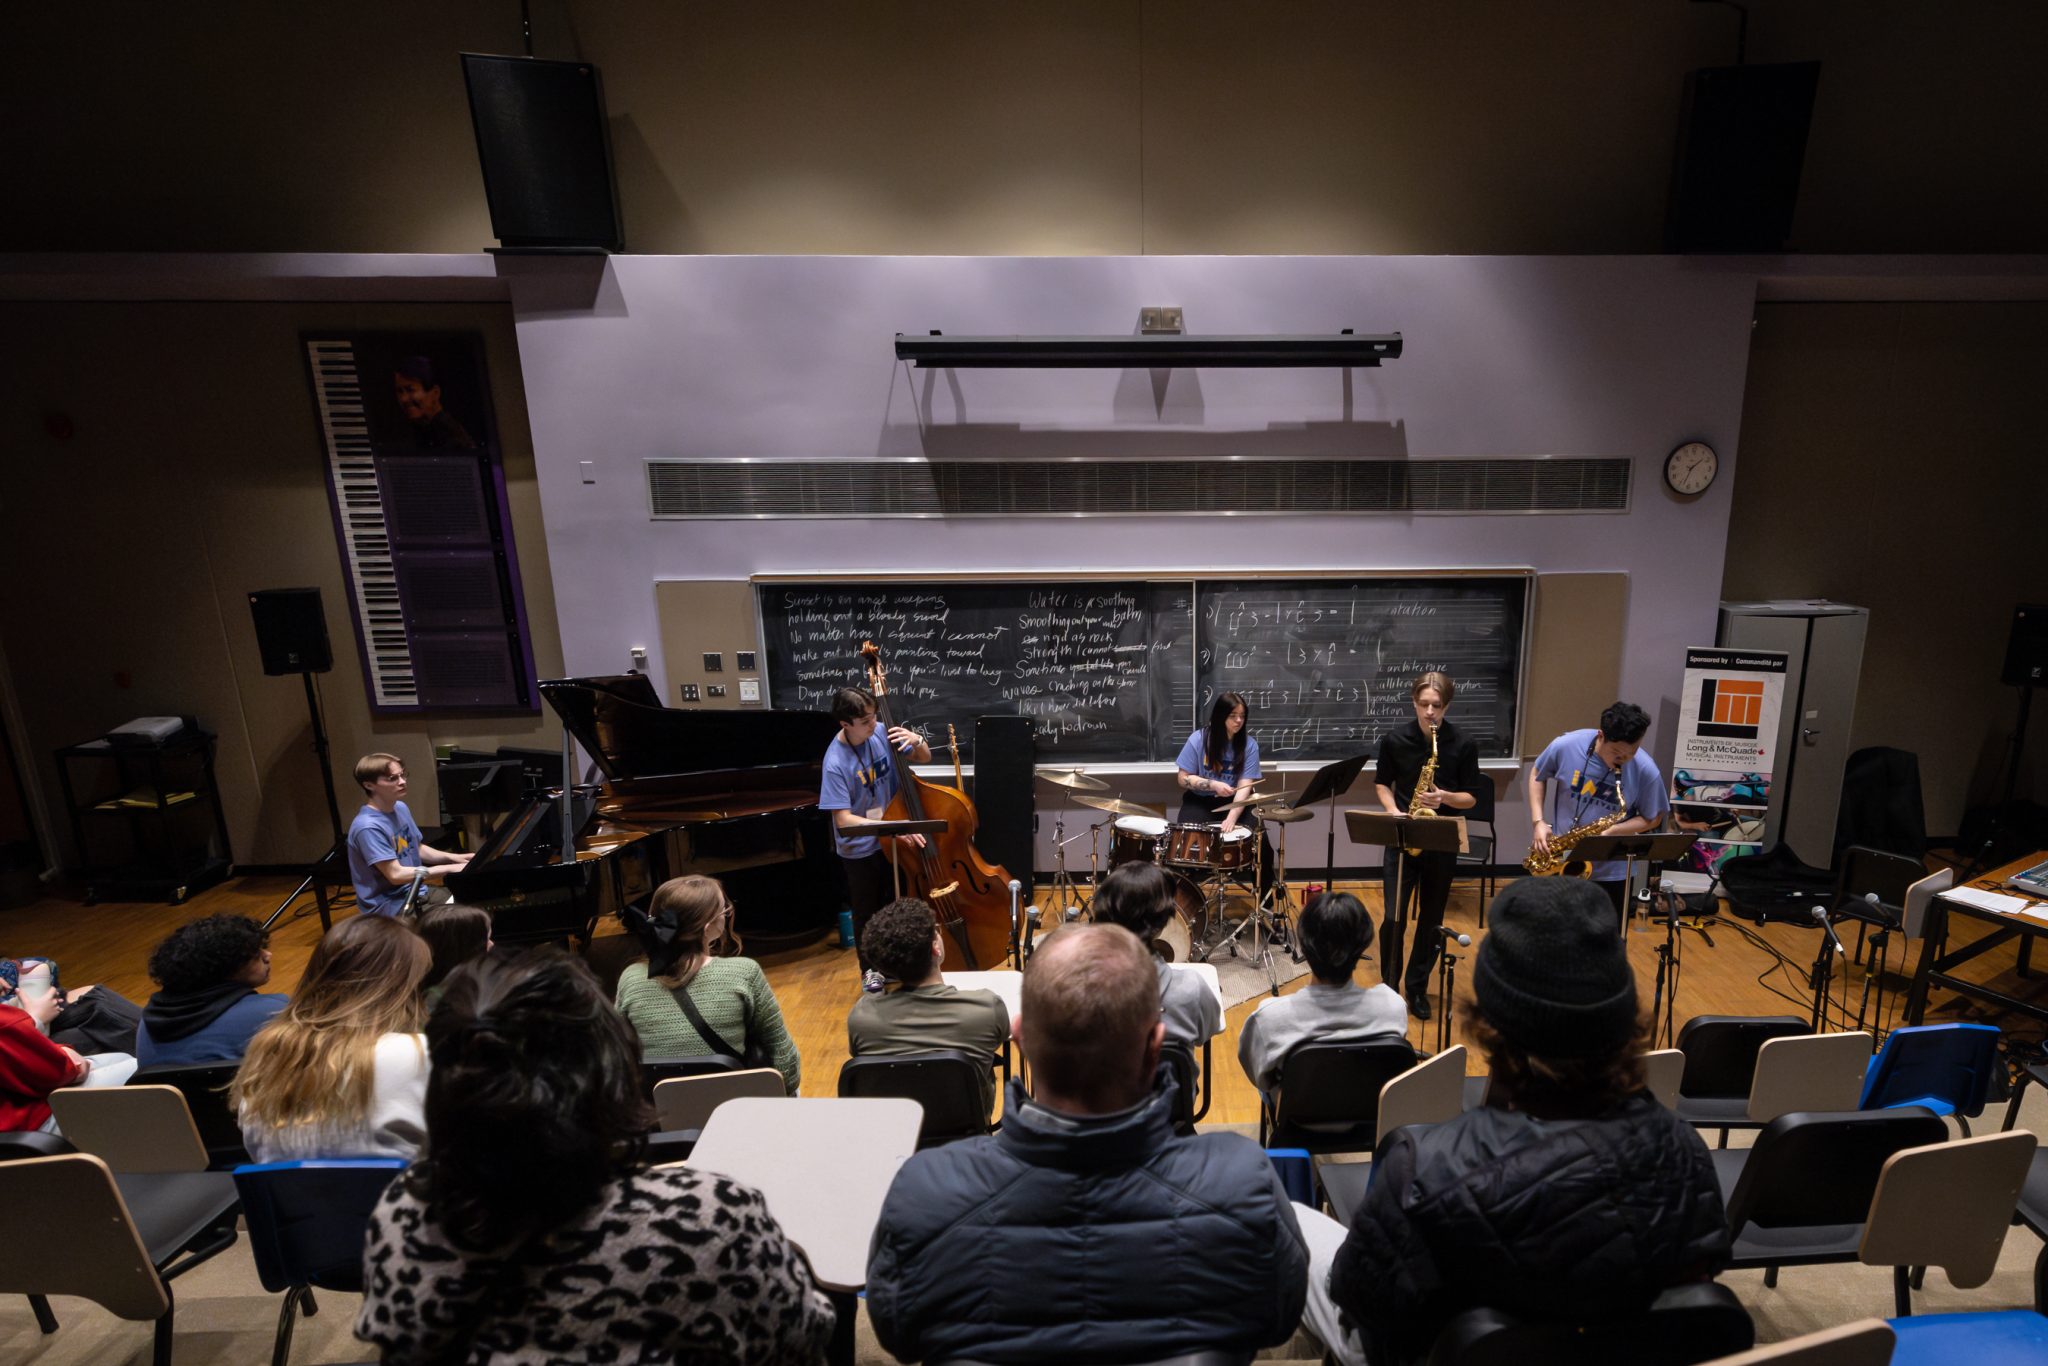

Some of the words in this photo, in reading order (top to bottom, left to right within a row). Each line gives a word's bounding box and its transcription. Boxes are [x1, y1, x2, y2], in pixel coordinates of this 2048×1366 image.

[1028, 591, 1068, 609] Water
[1073, 594, 1083, 609] is
[788, 608, 830, 631] holding
[834, 608, 853, 622] out
[790, 630, 802, 644] No
[809, 627, 844, 642] matter
[849, 625, 874, 639] how
[947, 626, 1009, 641] cannot
[1089, 632, 1113, 643] rock
[1689, 656, 1720, 664] Sponsored
[1720, 656, 1728, 664] by
[1687, 743, 1709, 752] Long
[1709, 744, 1715, 752] &
[1716, 745, 1758, 755] McQuade
